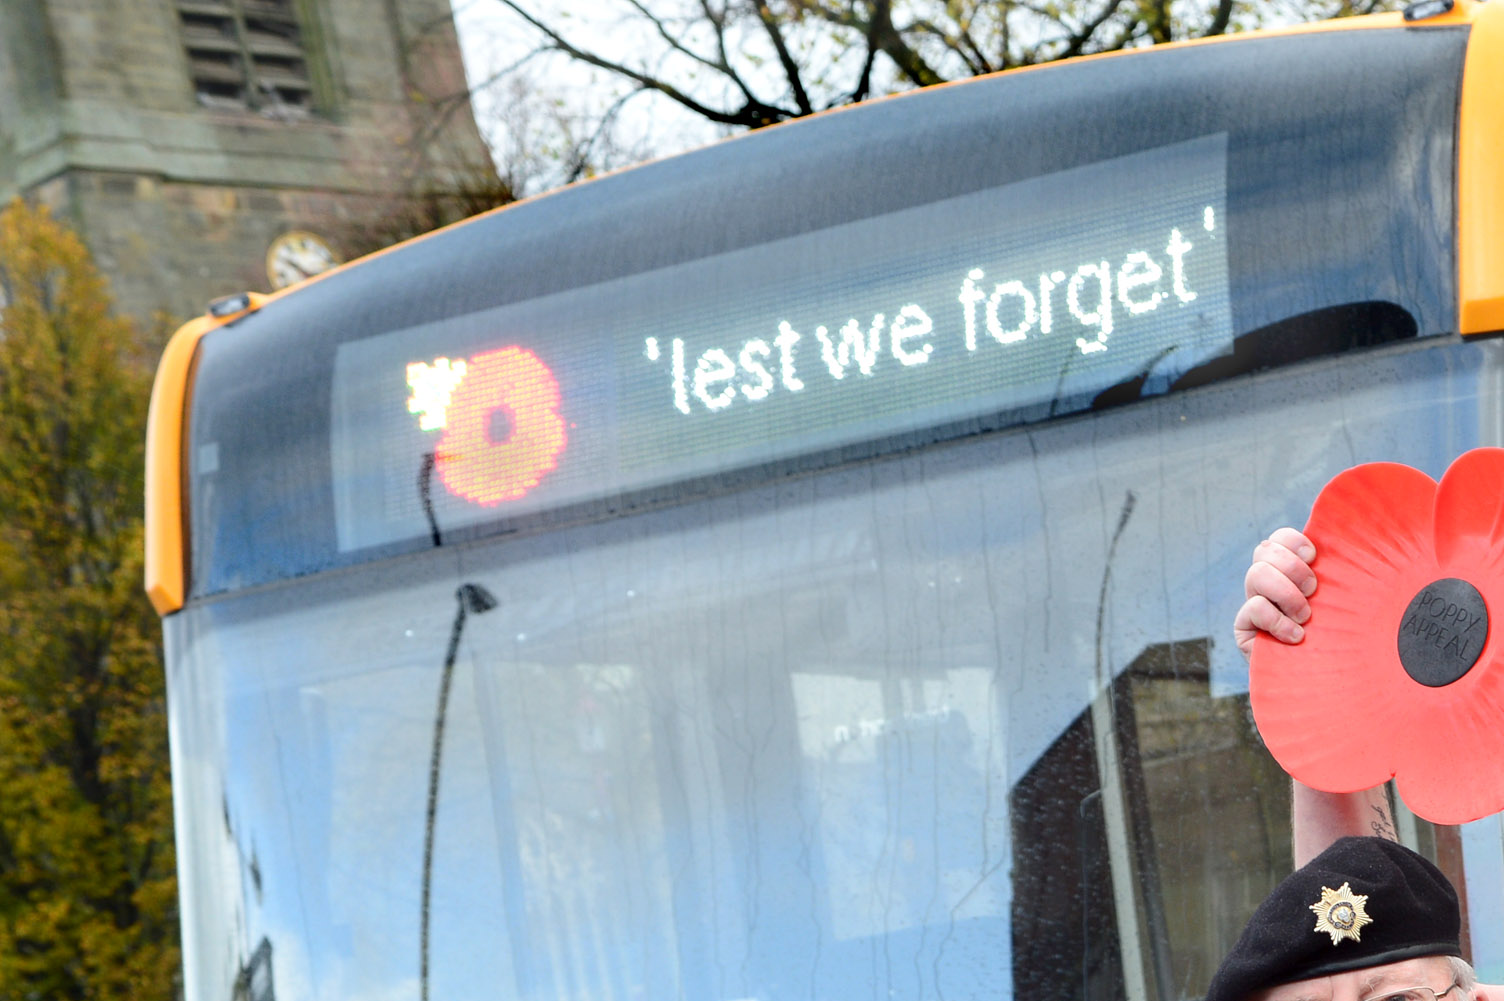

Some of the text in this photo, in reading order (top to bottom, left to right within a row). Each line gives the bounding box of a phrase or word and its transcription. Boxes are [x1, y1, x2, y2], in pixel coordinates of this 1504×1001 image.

[645, 206, 1215, 415] 'lest we forget'
[1418, 591, 1481, 633] POPPY
[1403, 614, 1468, 661] APPEAL
